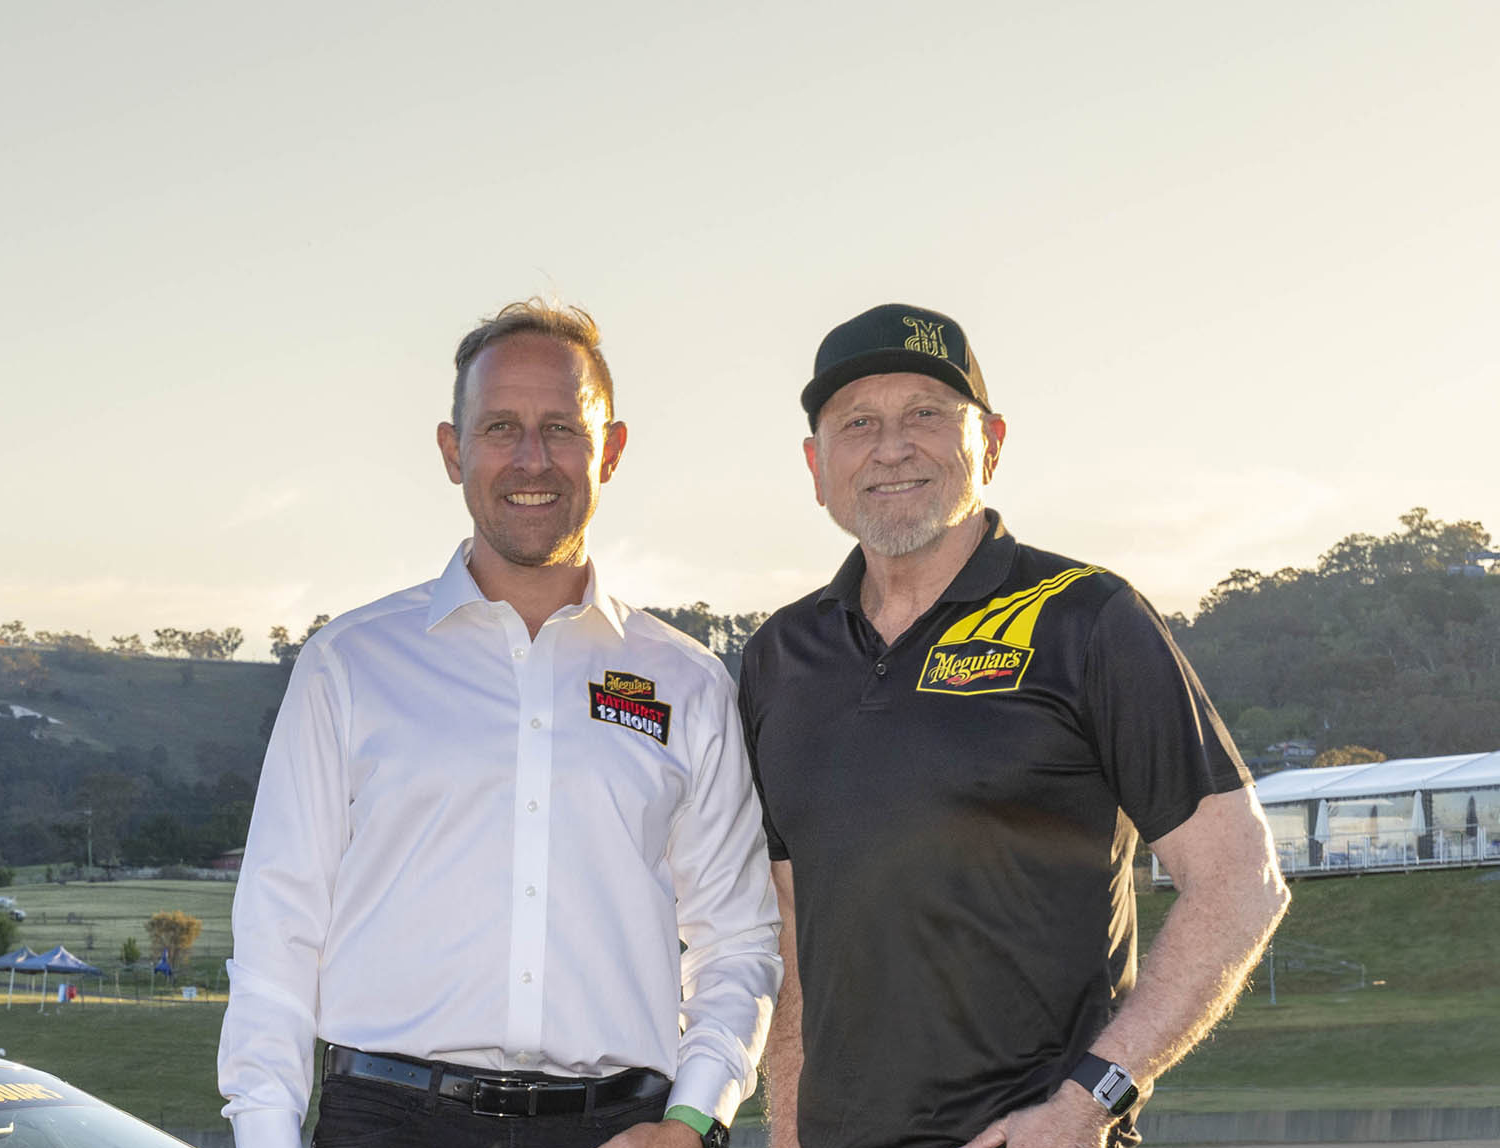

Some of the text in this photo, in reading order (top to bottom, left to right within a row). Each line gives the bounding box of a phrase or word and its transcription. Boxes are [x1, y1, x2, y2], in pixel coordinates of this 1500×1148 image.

[595, 692, 665, 723] BATHURST
[597, 704, 663, 740] 12 HOUR
